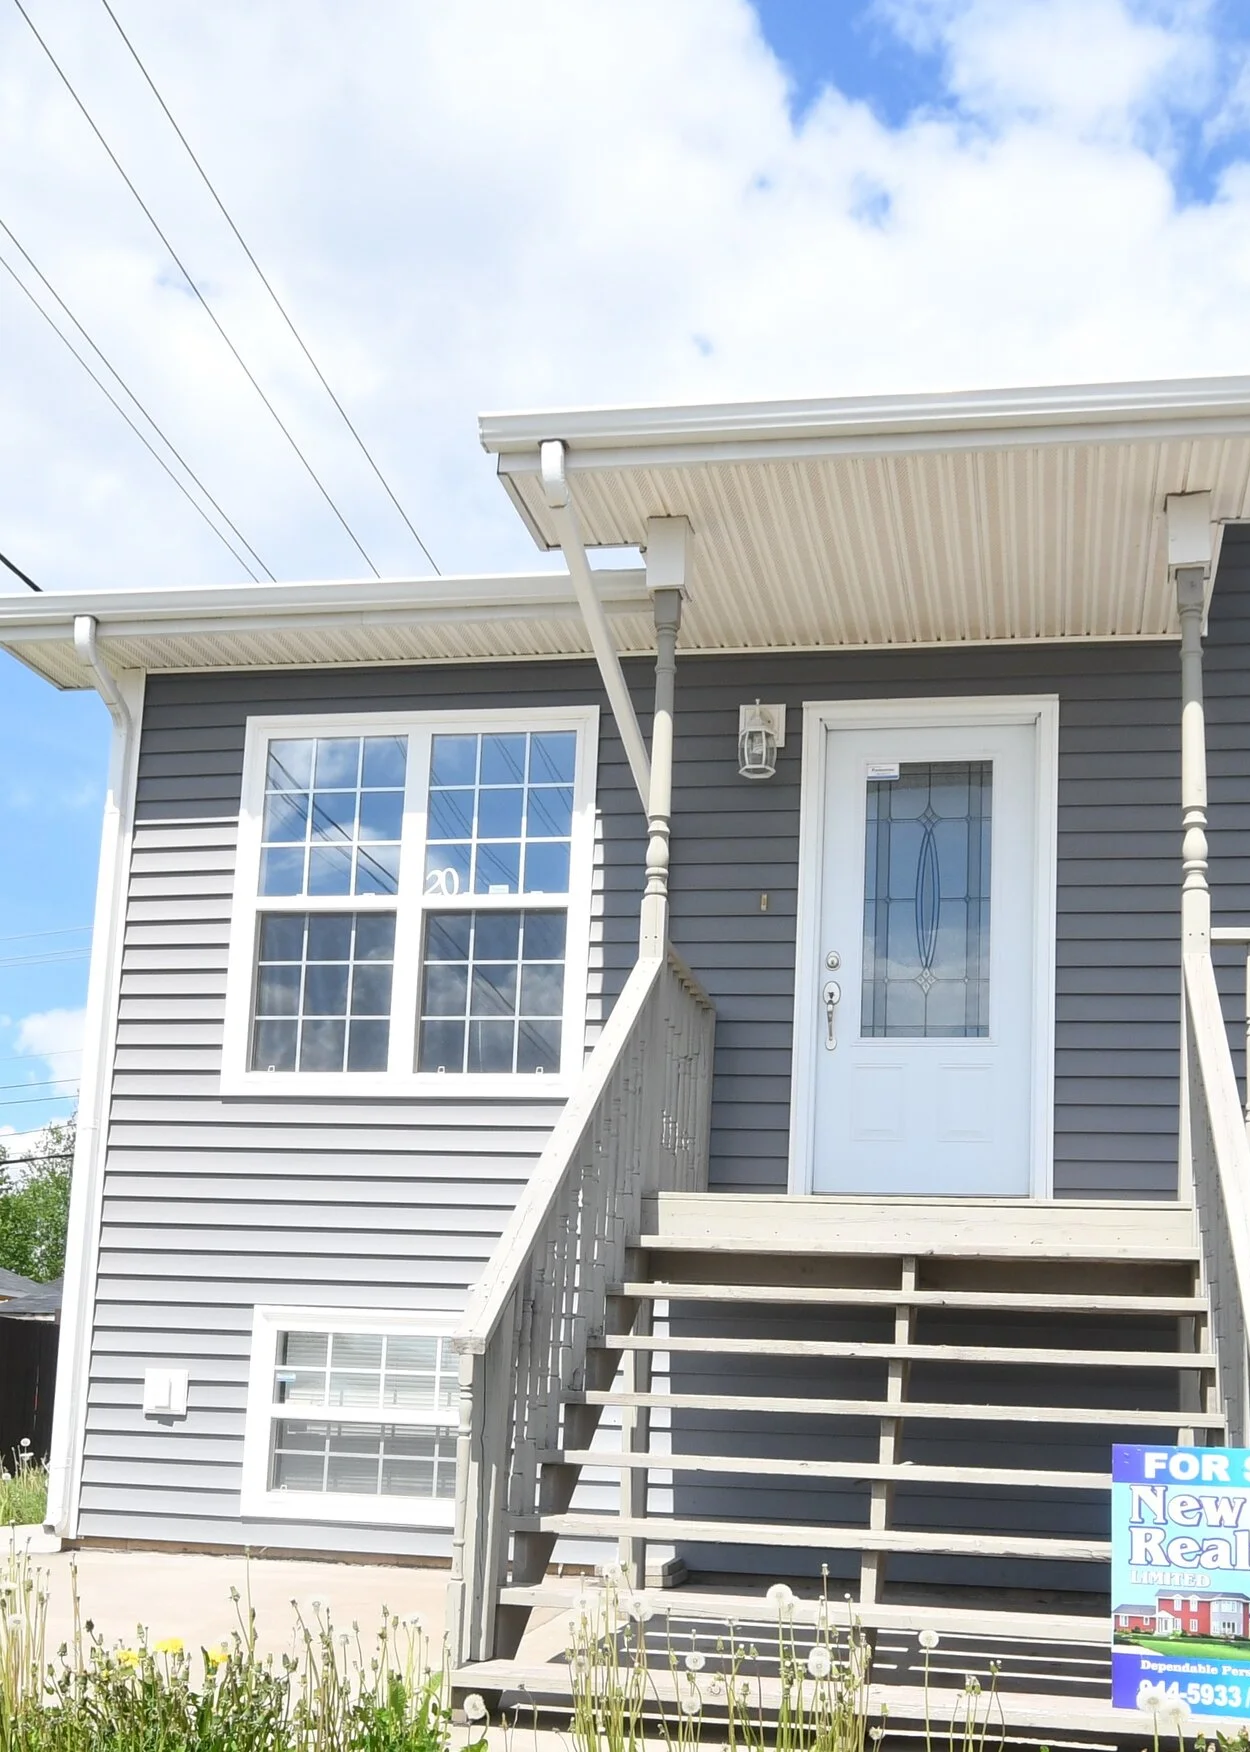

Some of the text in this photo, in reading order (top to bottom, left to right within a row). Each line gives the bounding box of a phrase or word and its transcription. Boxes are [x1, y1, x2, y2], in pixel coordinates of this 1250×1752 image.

[425, 867, 459, 896] 20
[1144, 1452, 1230, 1482] FOR
[1129, 1485, 1246, 1528] New
[1130, 1570, 1211, 1588] LIMITED
[1140, 1659, 1218, 1674] Dependable
